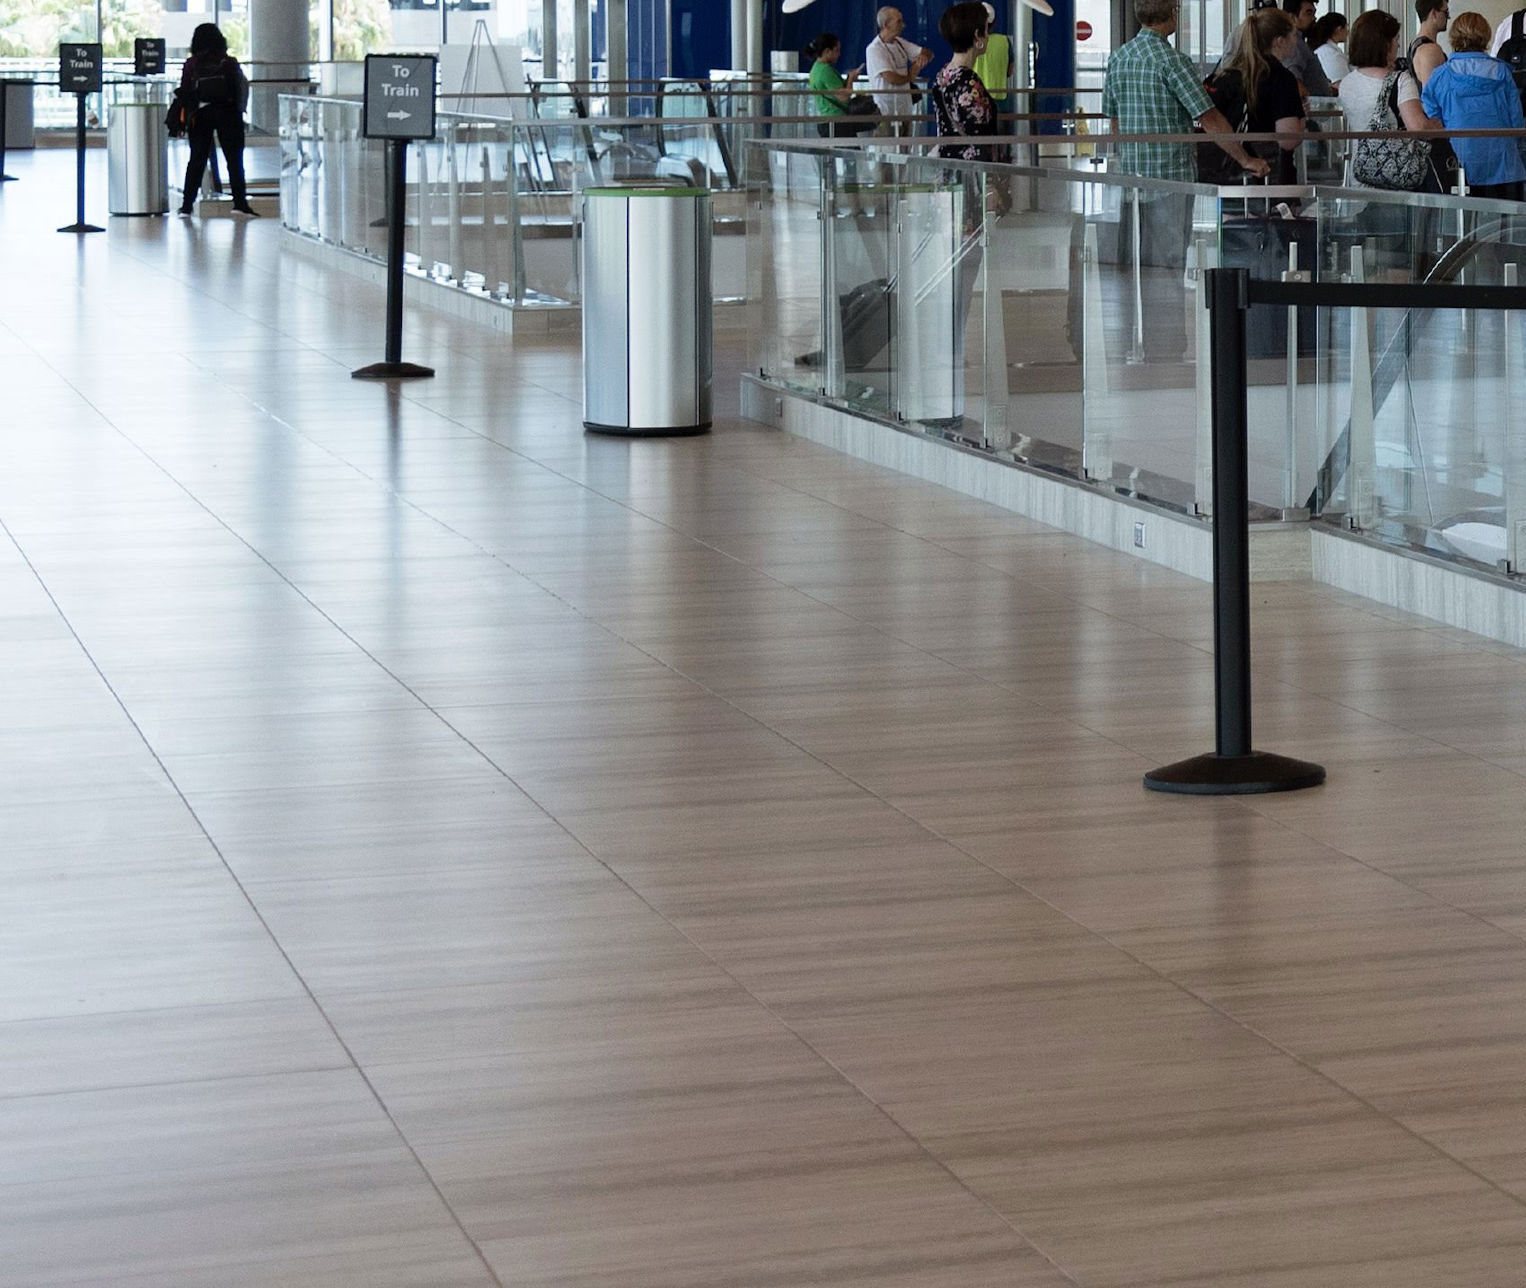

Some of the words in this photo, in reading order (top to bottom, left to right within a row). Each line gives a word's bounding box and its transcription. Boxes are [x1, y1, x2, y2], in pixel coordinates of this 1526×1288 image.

[75, 48, 88, 58] To
[69, 59, 94, 69] Train
[391, 64, 410, 78] To
[381, 83, 420, 97] Train
